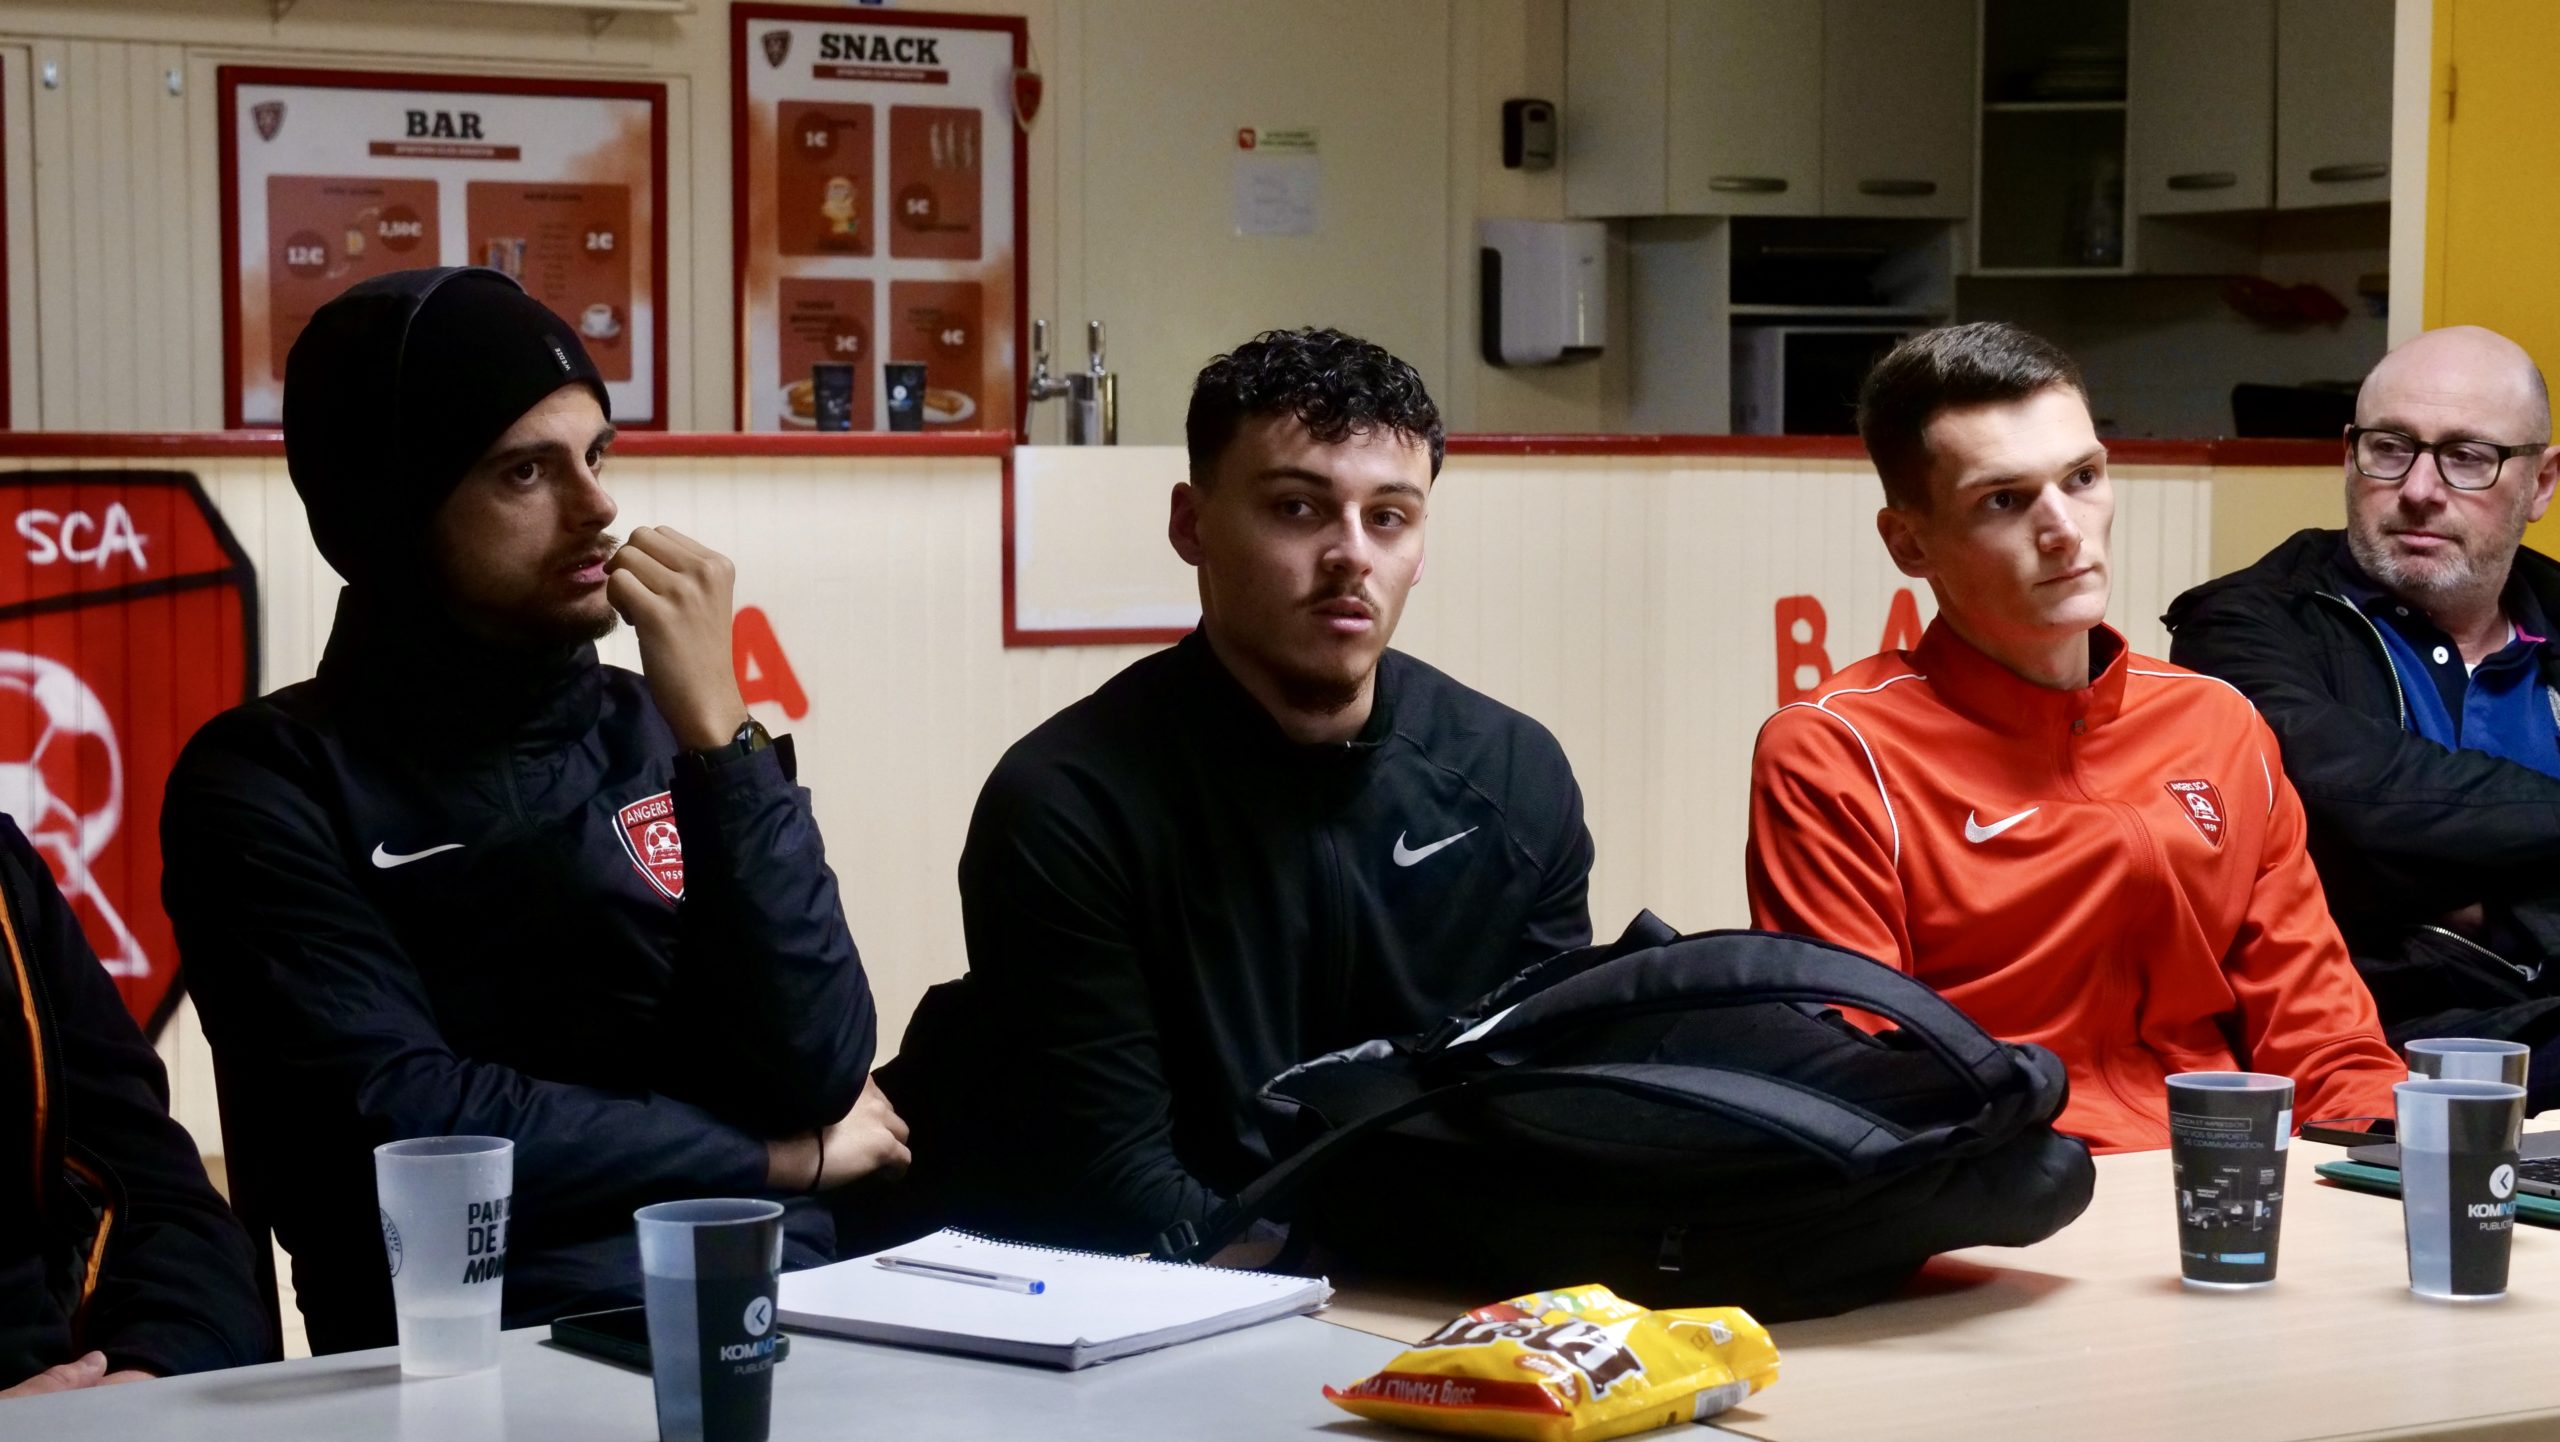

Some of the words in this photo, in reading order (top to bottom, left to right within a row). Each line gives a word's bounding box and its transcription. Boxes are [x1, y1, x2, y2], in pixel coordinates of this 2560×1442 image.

[820, 32, 939, 64] SNACK
[406, 111, 484, 139] BAR
[16, 501, 149, 572] SCA
[627, 800, 669, 825] ANGERS
[661, 870, 684, 881] 1959
[468, 1224, 498, 1256] DE
